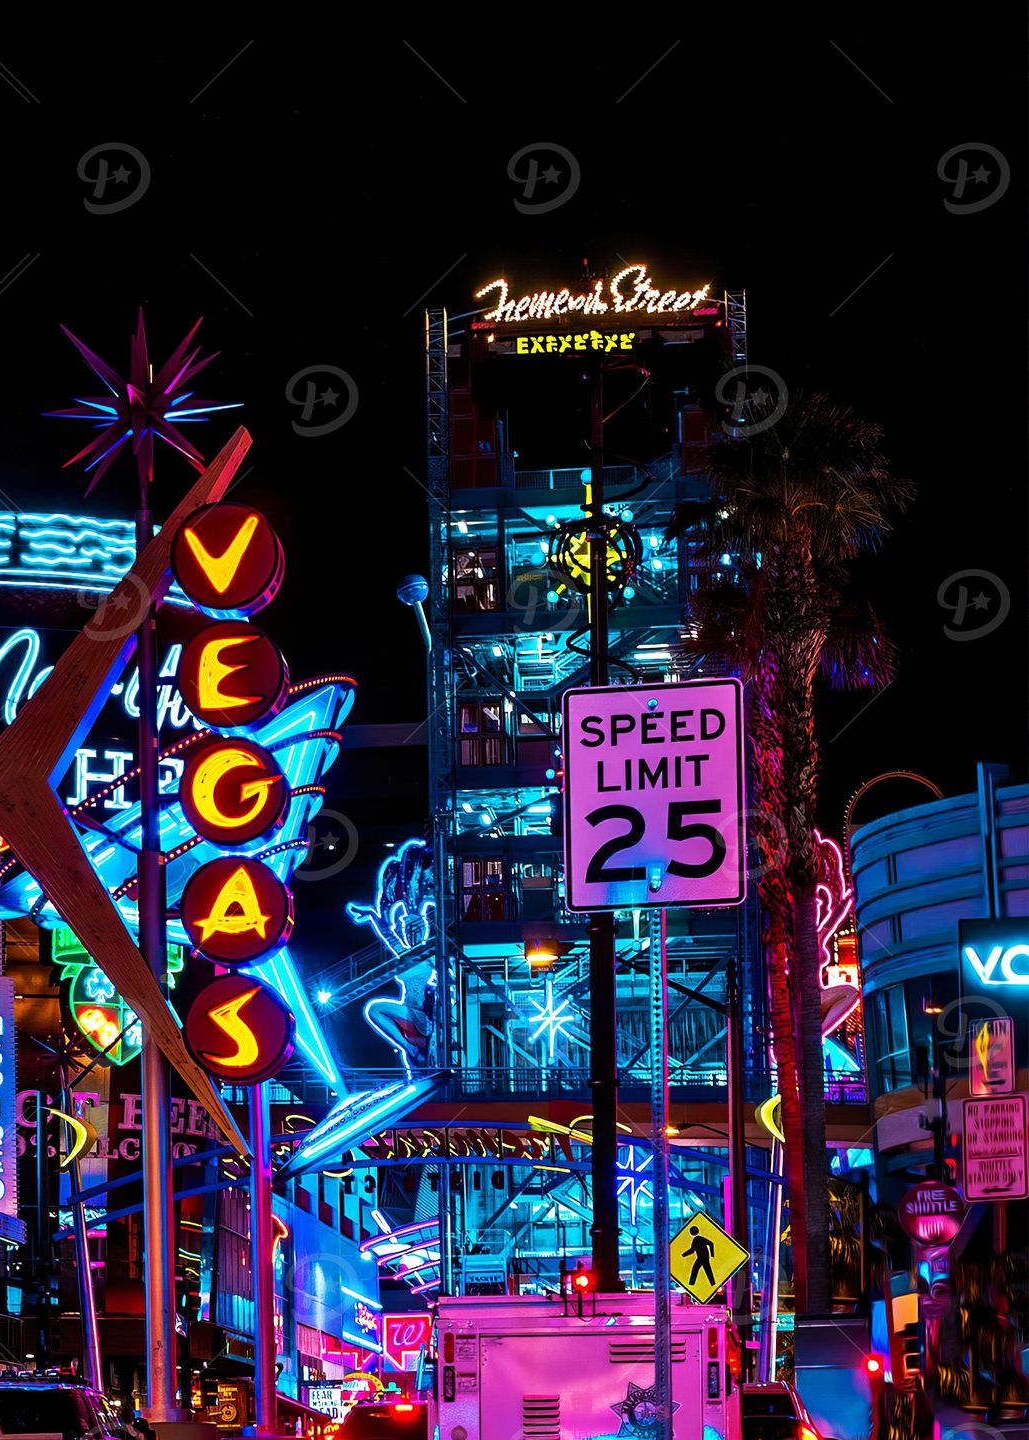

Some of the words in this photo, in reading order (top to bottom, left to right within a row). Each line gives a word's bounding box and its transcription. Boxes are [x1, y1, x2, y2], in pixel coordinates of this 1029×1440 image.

[610, 263, 712, 314] Street
[580, 708, 726, 748] SPEED
[183, 512, 282, 1067] VEGAS
[596, 754, 710, 793] LIMIT
[584, 799, 727, 884] 25
[984, 1102, 1020, 1114] PARKING
[905, 1199, 958, 1215] SHUTTLE
[917, 1189, 946, 1202] FREE
